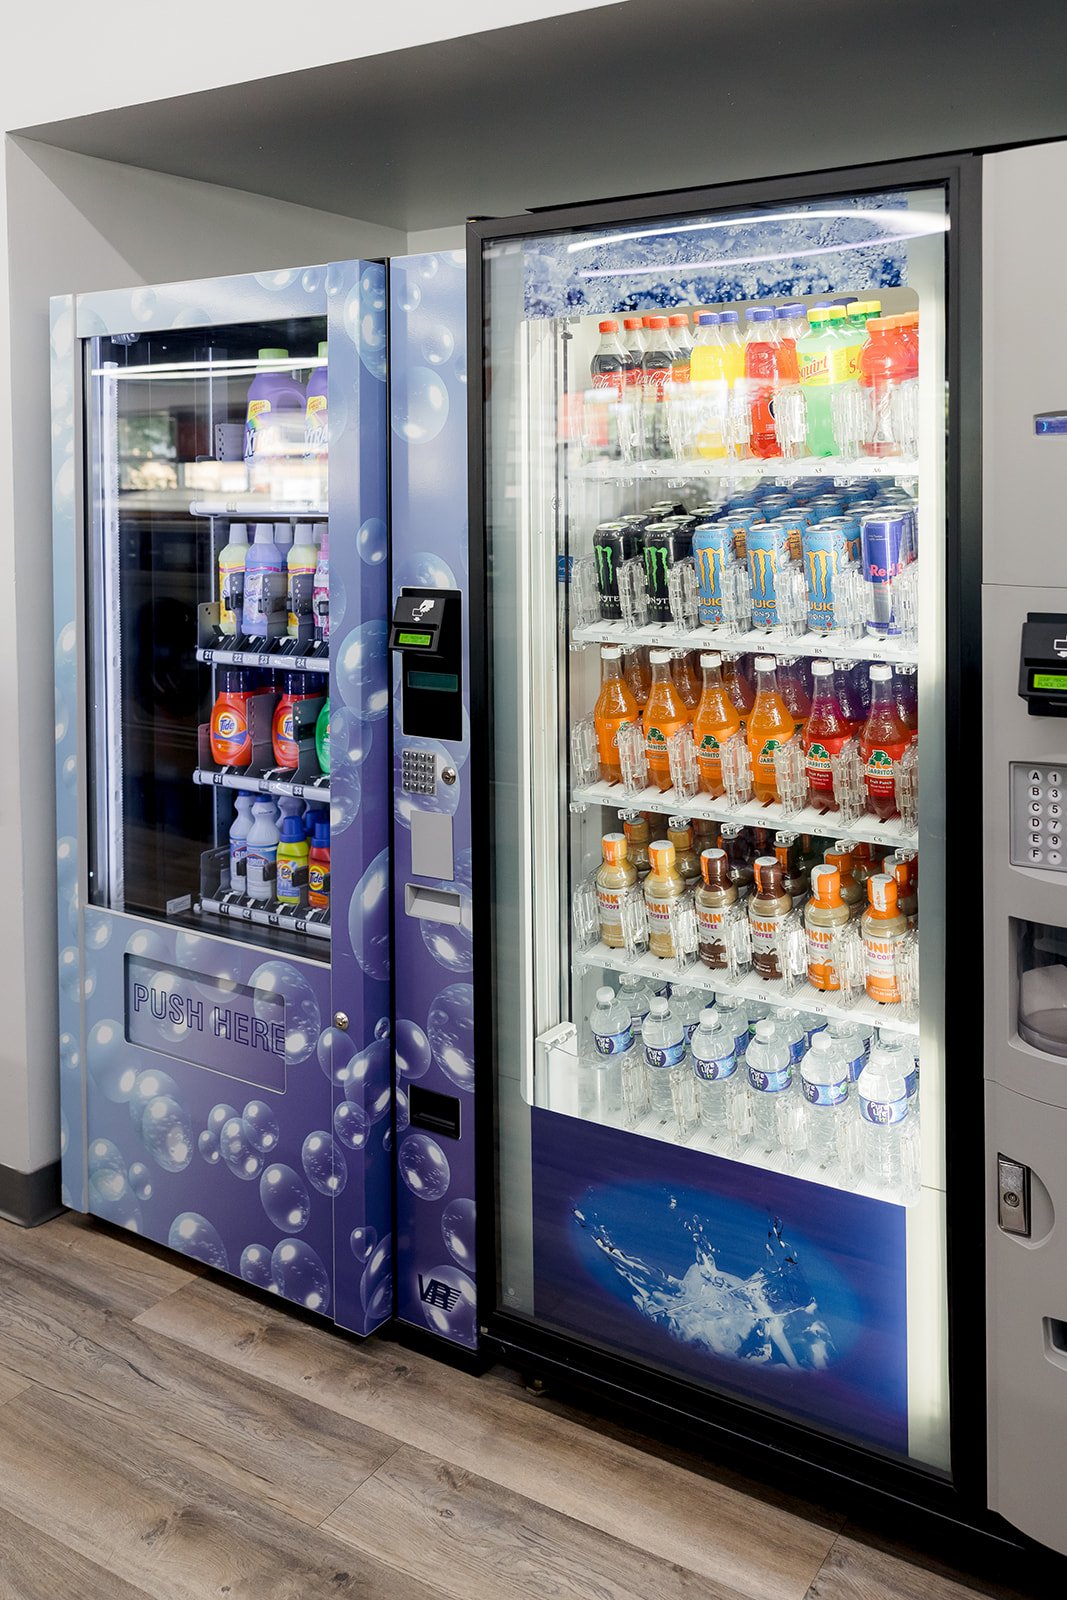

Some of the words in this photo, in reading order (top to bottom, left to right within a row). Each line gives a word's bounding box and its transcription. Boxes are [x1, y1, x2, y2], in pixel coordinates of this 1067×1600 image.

[870, 564, 895, 577] Red
[220, 720, 235, 733] Tide
[1032, 772, 1040, 781] A
[1052, 774, 1057, 782] 1
[1032, 787, 1040, 796] B
[1052, 789, 1058, 798] 3
[1032, 802, 1040, 812] C
[1052, 805, 1058, 814] 5
[1032, 818, 1040, 827] D
[1052, 821, 1058, 829] 7
[1032, 834, 1039, 843] E
[1052, 836, 1058, 845] 9
[1032, 849, 1039, 858] F
[133, 983, 204, 1032] PUSH
[214, 1006, 286, 1057] HERE
